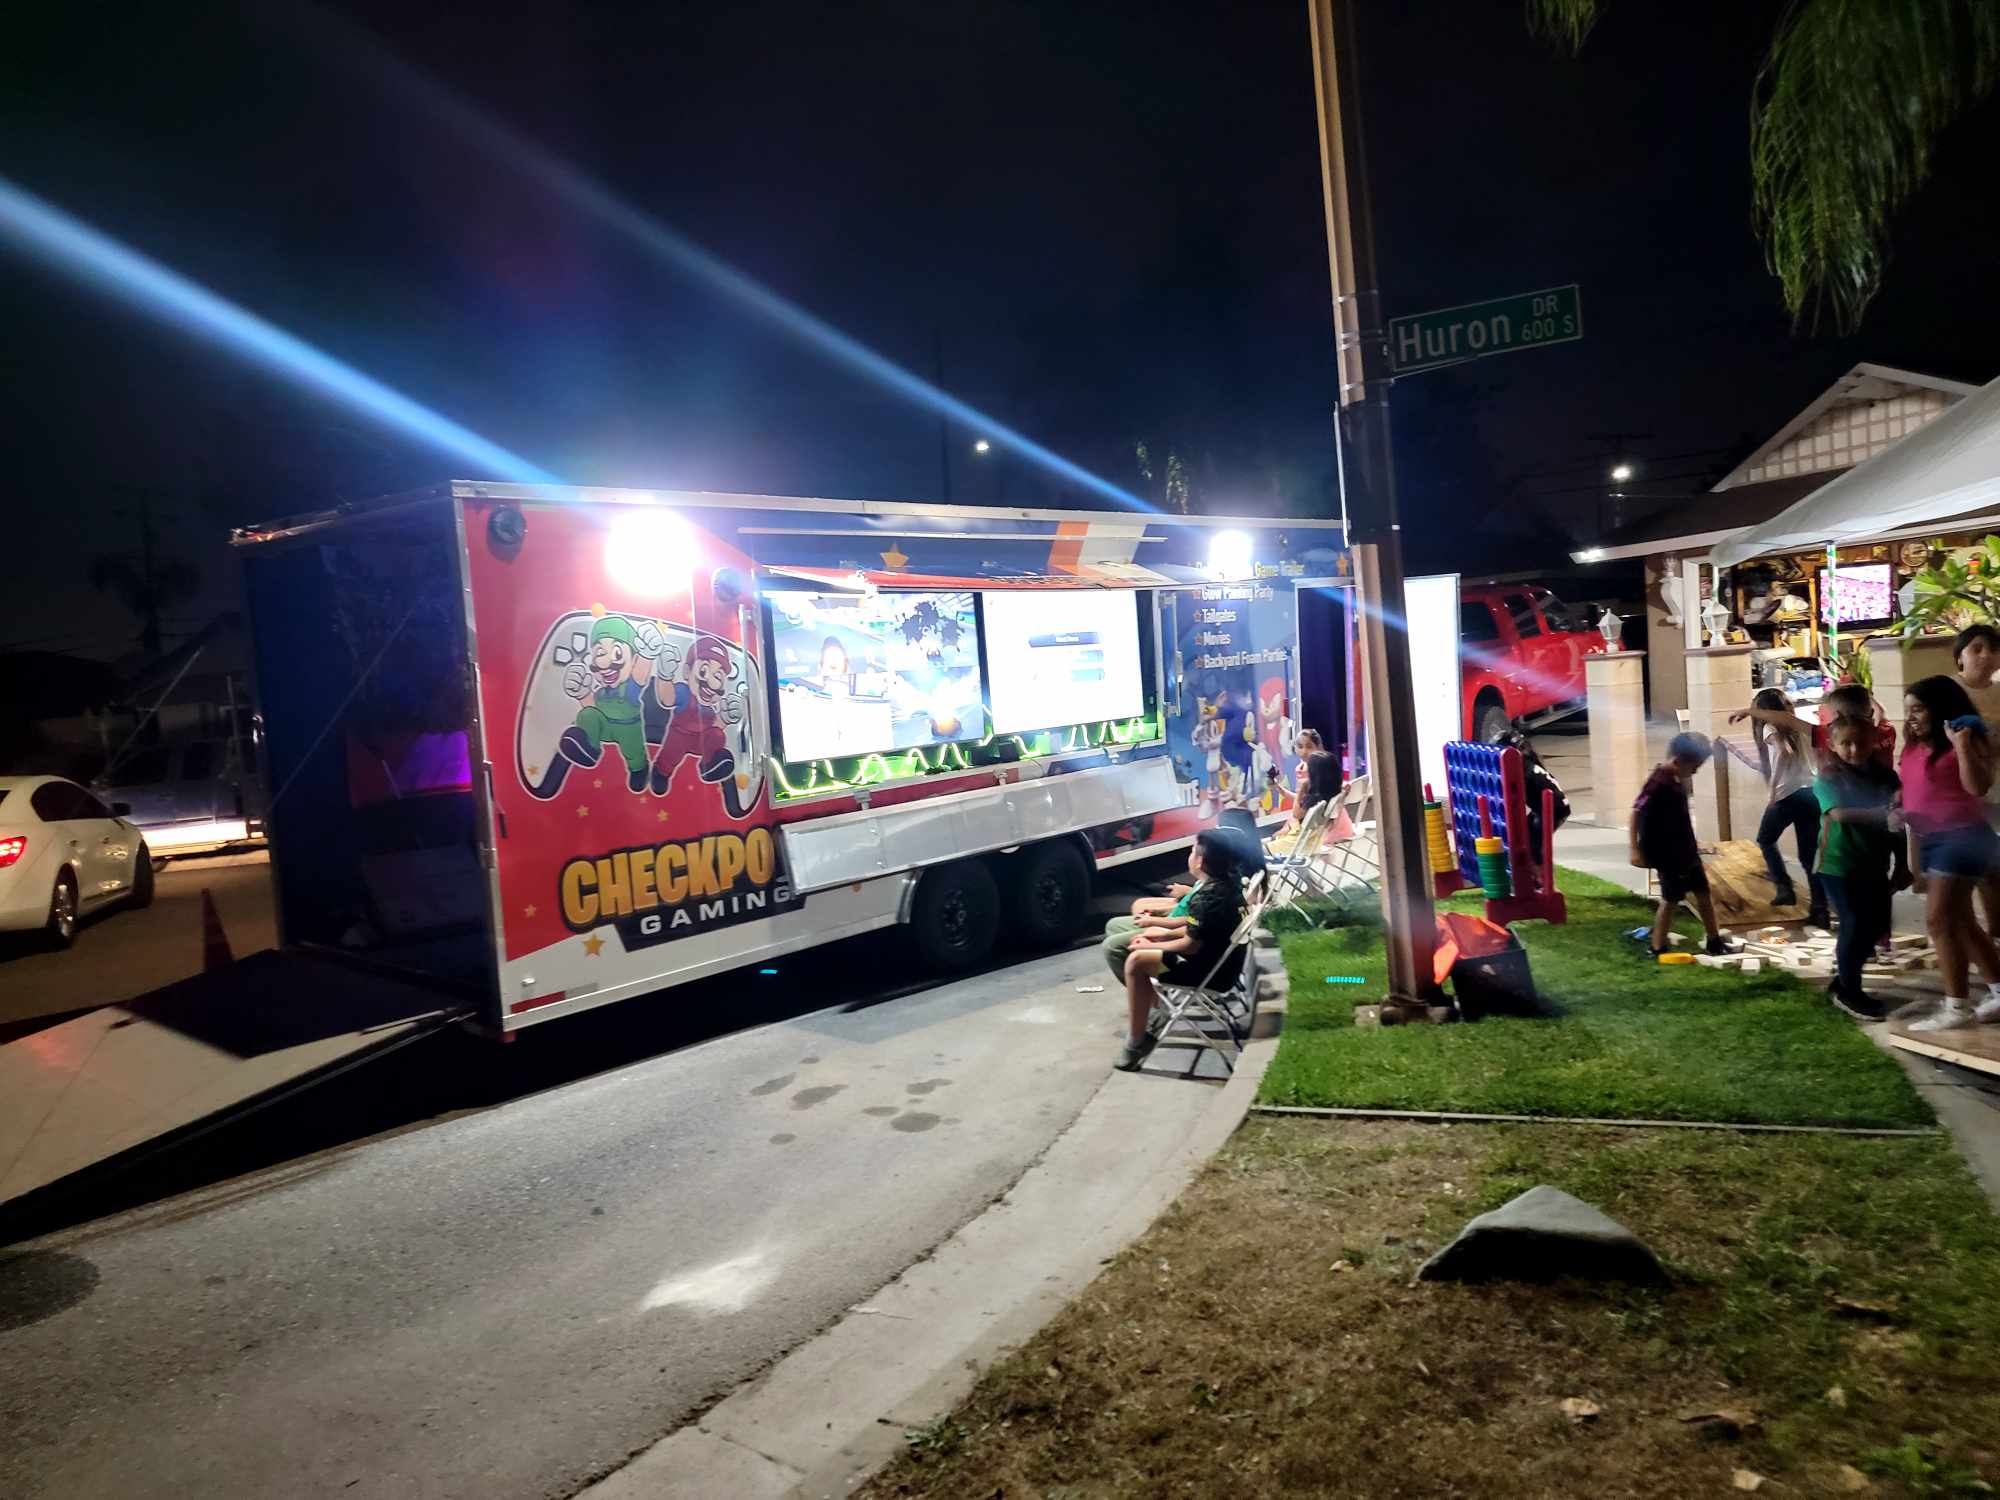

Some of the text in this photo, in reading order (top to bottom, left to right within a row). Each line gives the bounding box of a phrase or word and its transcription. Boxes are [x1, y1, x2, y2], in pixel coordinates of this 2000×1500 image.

[1532, 295, 1559, 317] DR
[1398, 314, 1512, 363] Huron
[1521, 315, 1575, 342] 600 S
[1202, 608, 1237, 626] Tailgates
[1203, 631, 1232, 647] Movies
[1203, 651, 1241, 671] Backyard
[1241, 650, 1262, 666] Foam
[640, 886, 794, 936] GAMING
